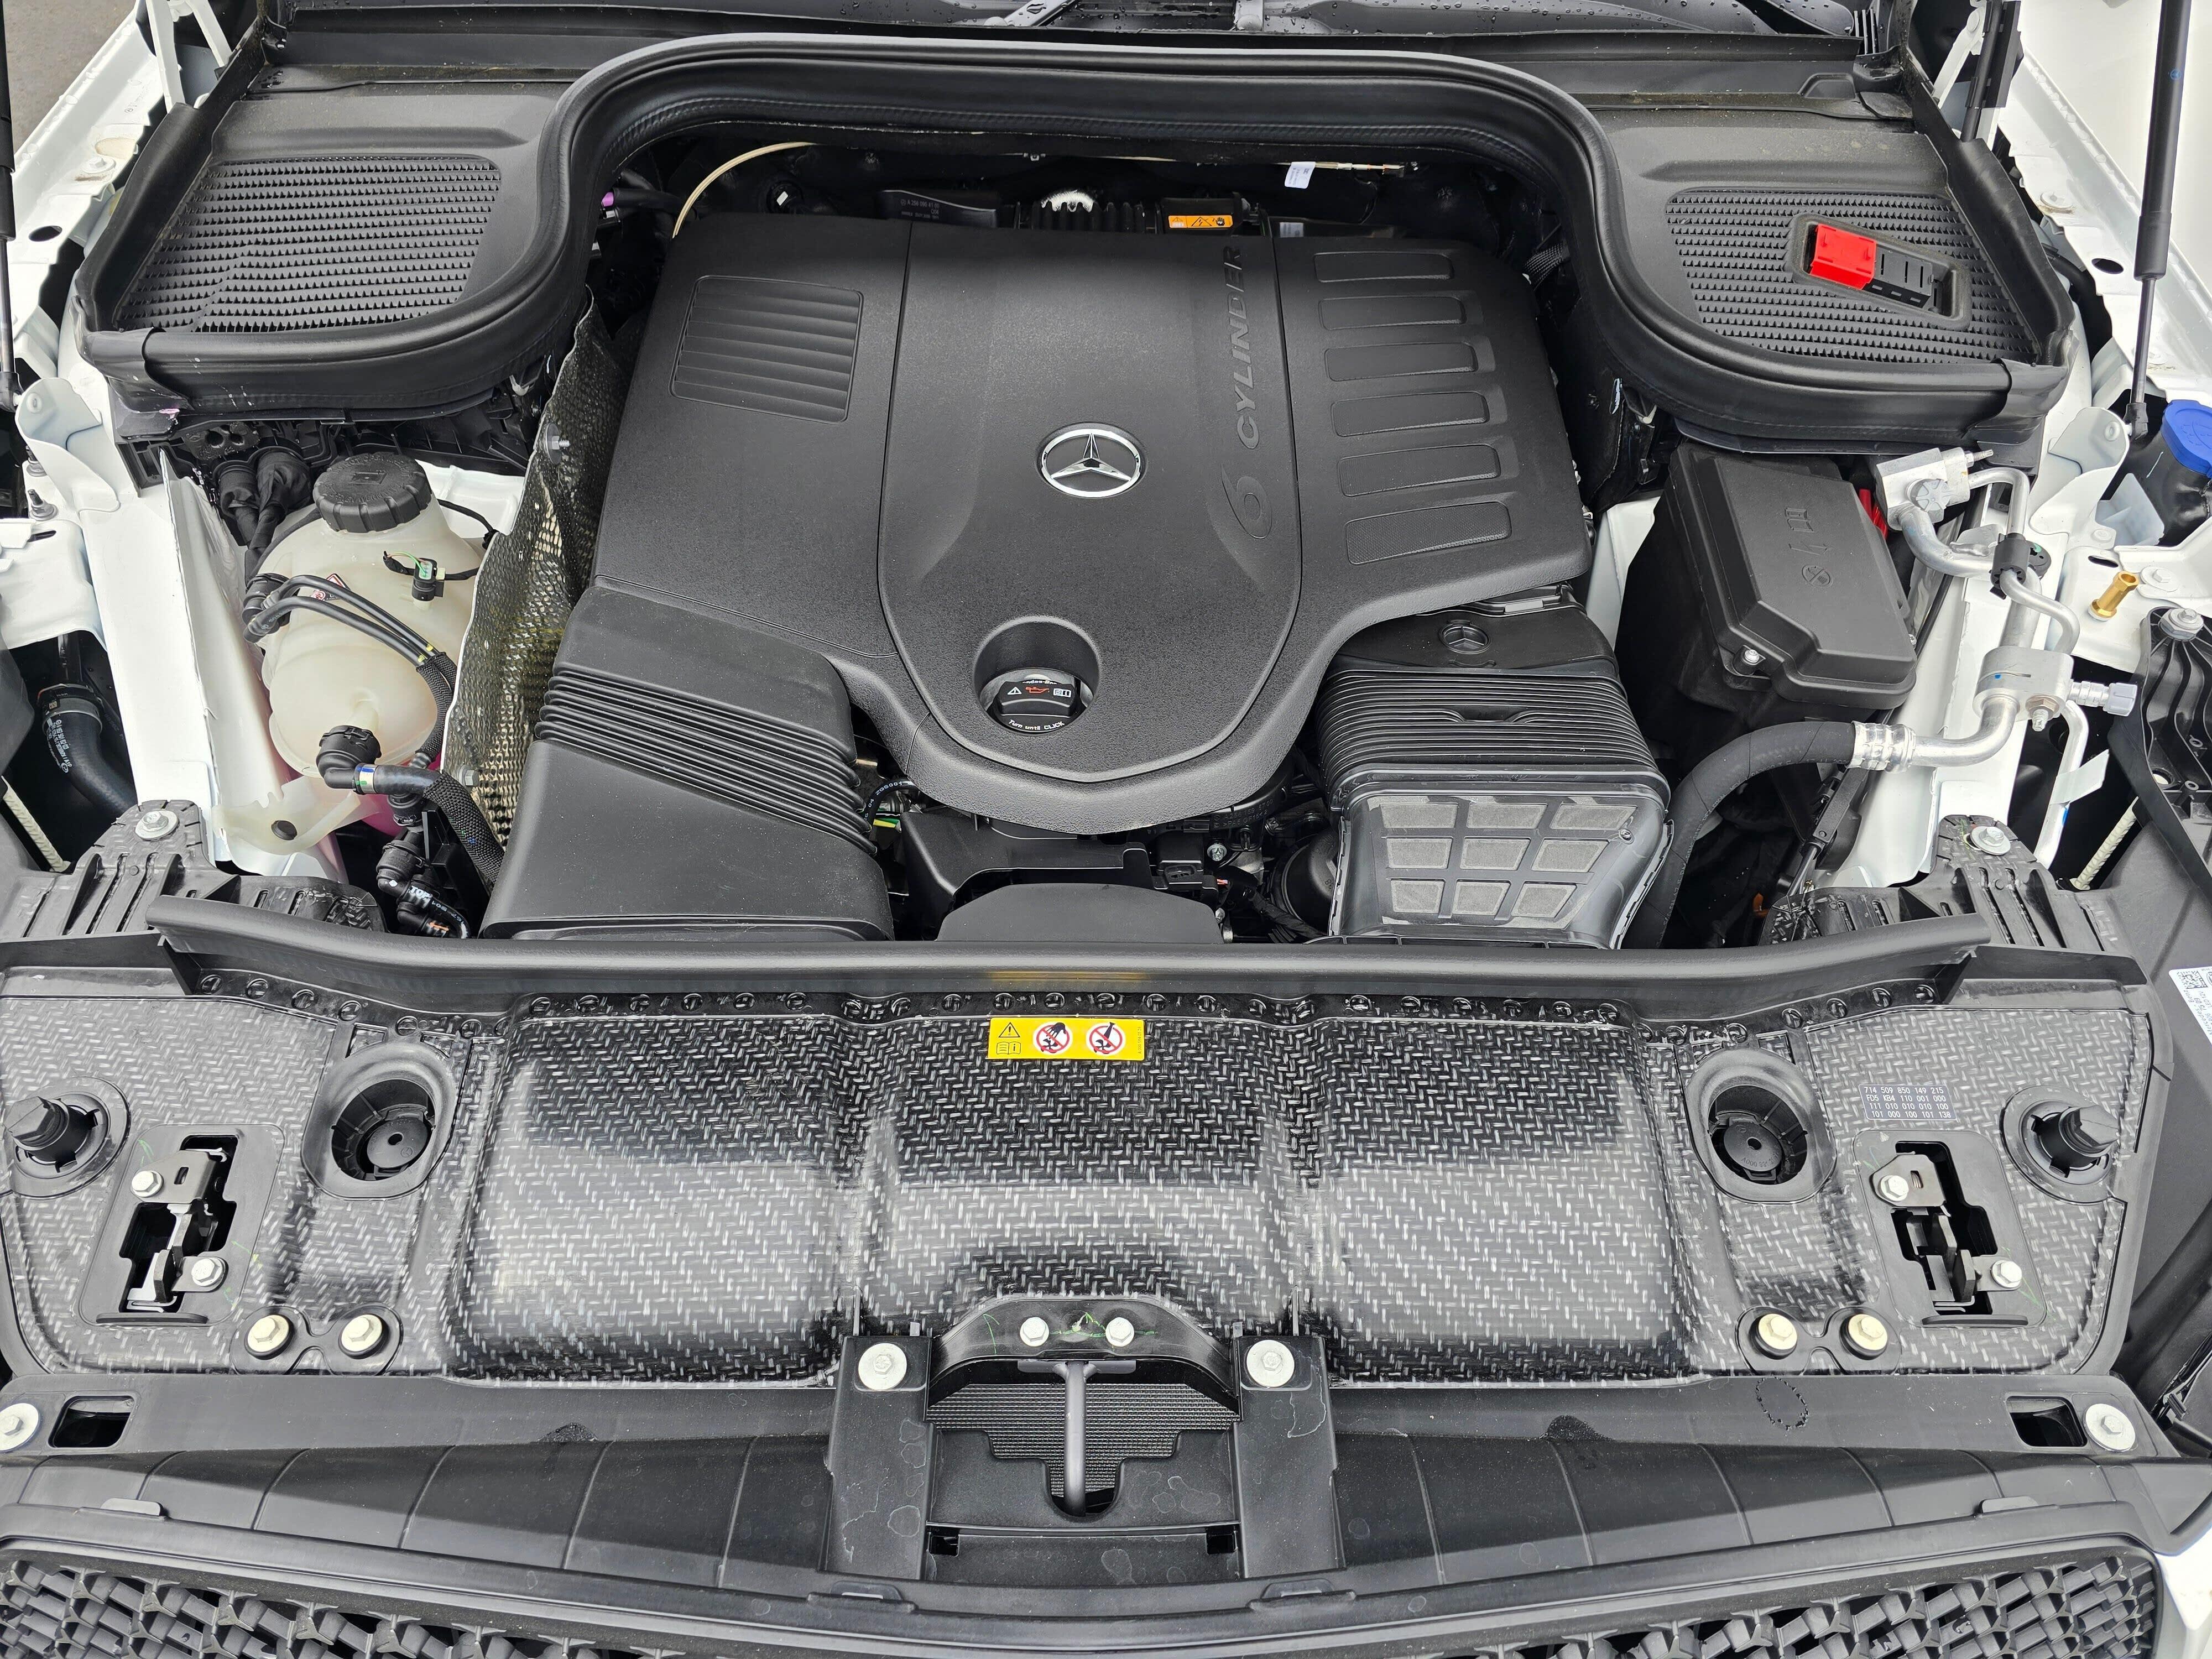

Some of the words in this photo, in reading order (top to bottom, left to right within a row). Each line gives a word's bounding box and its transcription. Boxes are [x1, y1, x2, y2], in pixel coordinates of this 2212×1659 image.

[1223, 247, 1260, 449] CYLINDER
[1221, 463, 1272, 539] 6
[1008, 719, 1023, 728] Turn
[1044, 721, 1065, 730] CLICK
